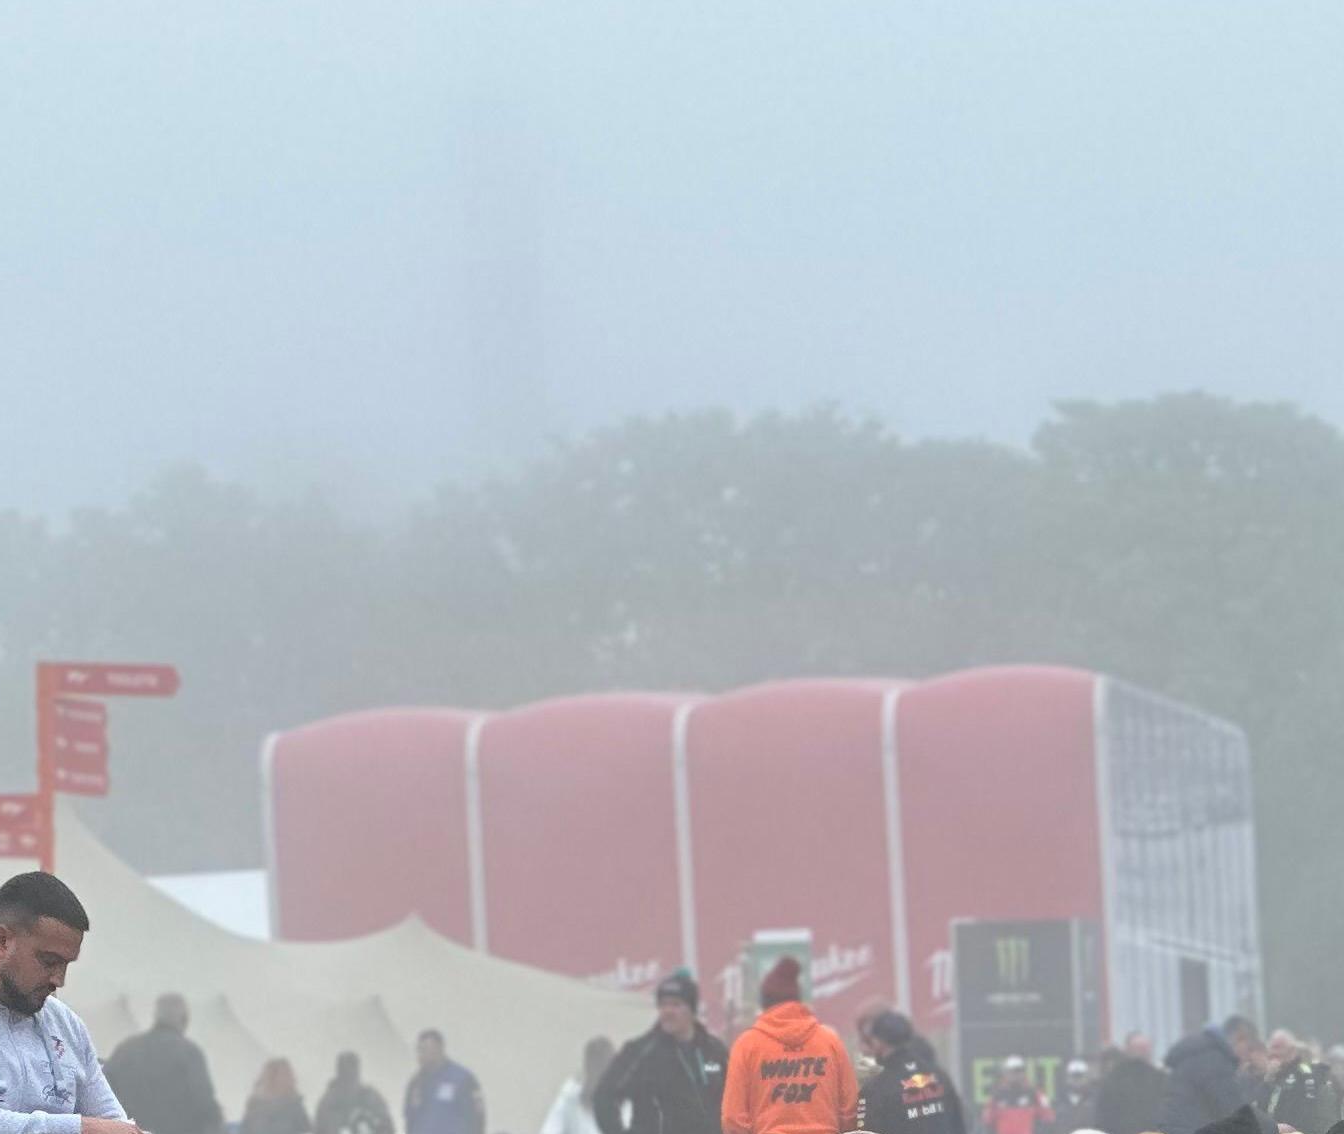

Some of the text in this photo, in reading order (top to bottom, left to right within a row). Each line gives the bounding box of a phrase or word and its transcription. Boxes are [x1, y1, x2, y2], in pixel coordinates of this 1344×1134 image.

[760, 1056, 828, 1080] WHITE
[973, 1057, 1062, 1104] EIT
[771, 1082, 817, 1103] FOX
[907, 1104, 936, 1119] Mbil
